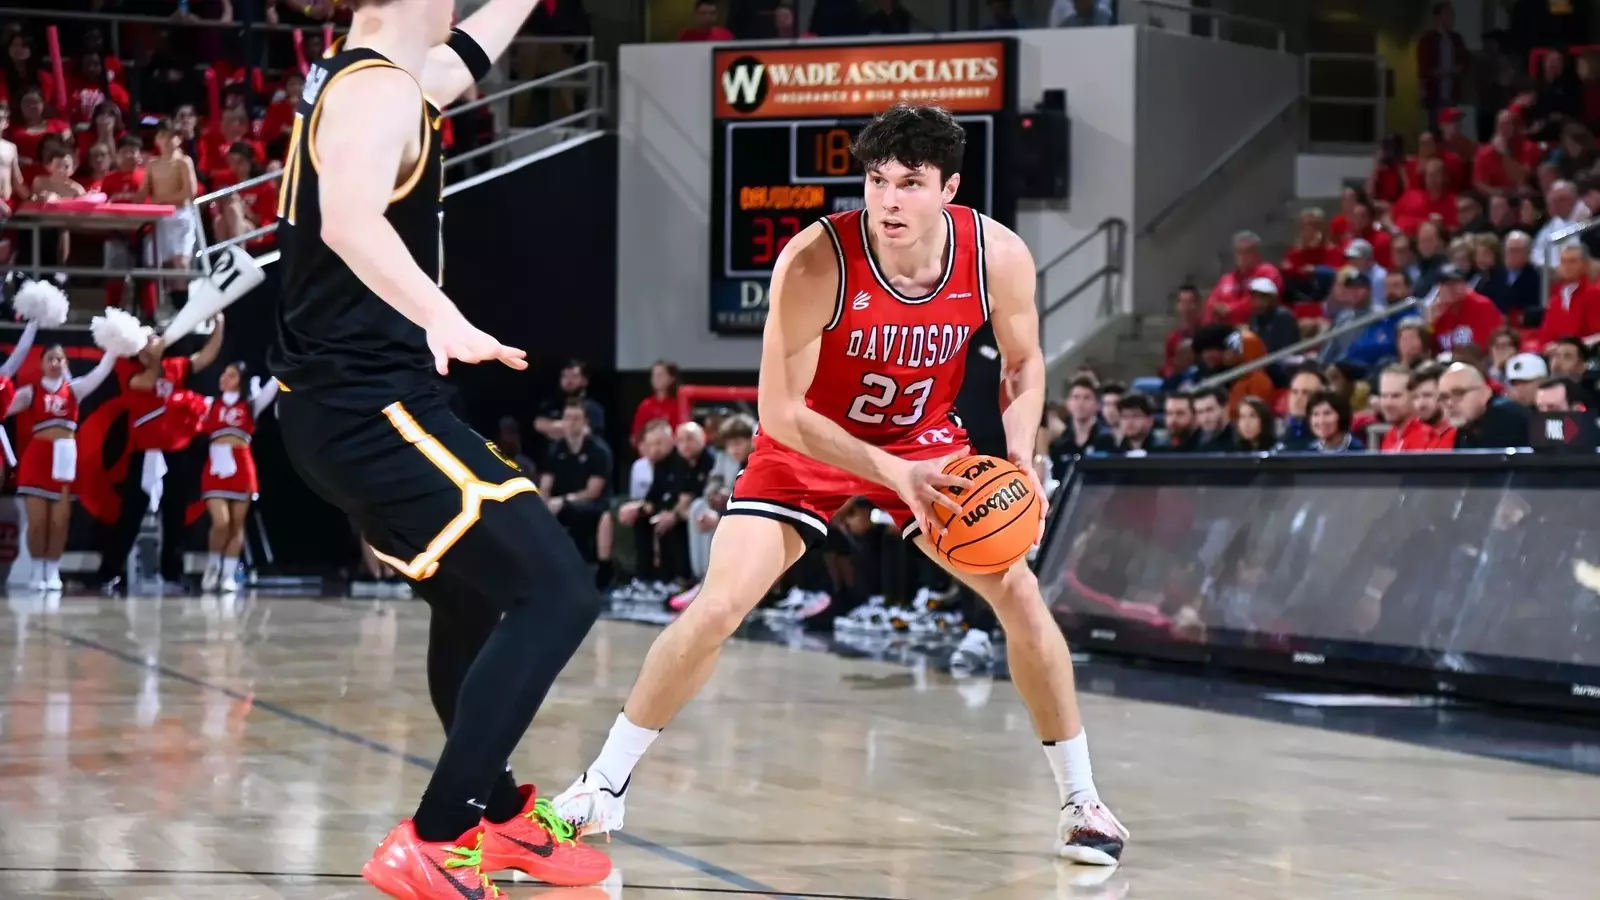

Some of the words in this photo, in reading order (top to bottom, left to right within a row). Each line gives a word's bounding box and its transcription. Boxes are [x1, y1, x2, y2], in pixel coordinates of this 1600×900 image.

[722, 64, 766, 104] W
[768, 63, 841, 87] WADE
[845, 58, 998, 85] ASSOCIATES
[846, 324, 971, 368] DAVIDSON
[847, 372, 936, 425] 23
